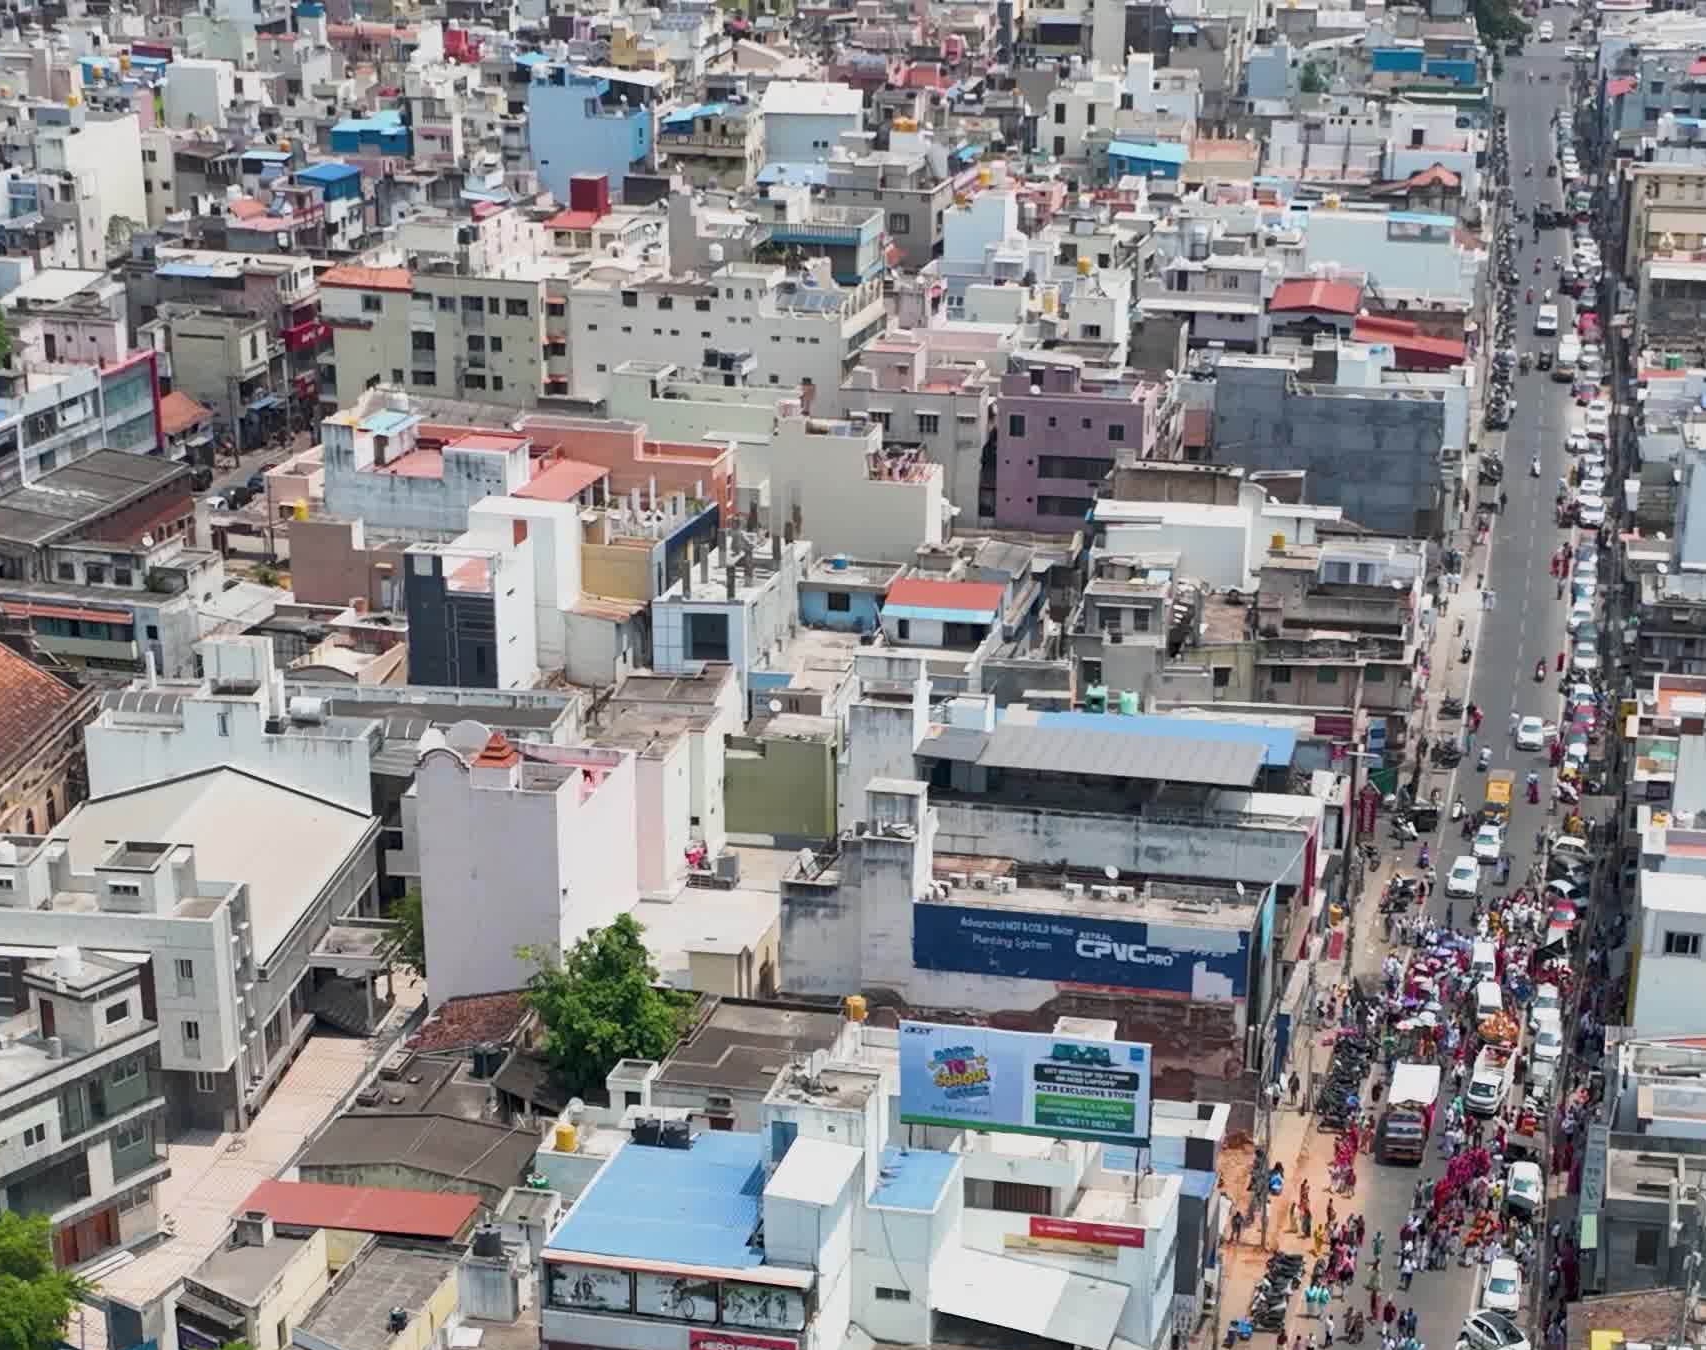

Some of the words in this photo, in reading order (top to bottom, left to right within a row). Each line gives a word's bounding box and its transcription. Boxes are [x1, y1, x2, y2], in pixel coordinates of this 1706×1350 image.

[1076, 939, 1147, 965] CPVC
[1146, 953, 1174, 967] PRO
[1036, 1084, 1058, 1093] ACER
[1060, 1086, 1105, 1097] EXCLUSIVE
[1108, 1090, 1135, 1099] STORE
